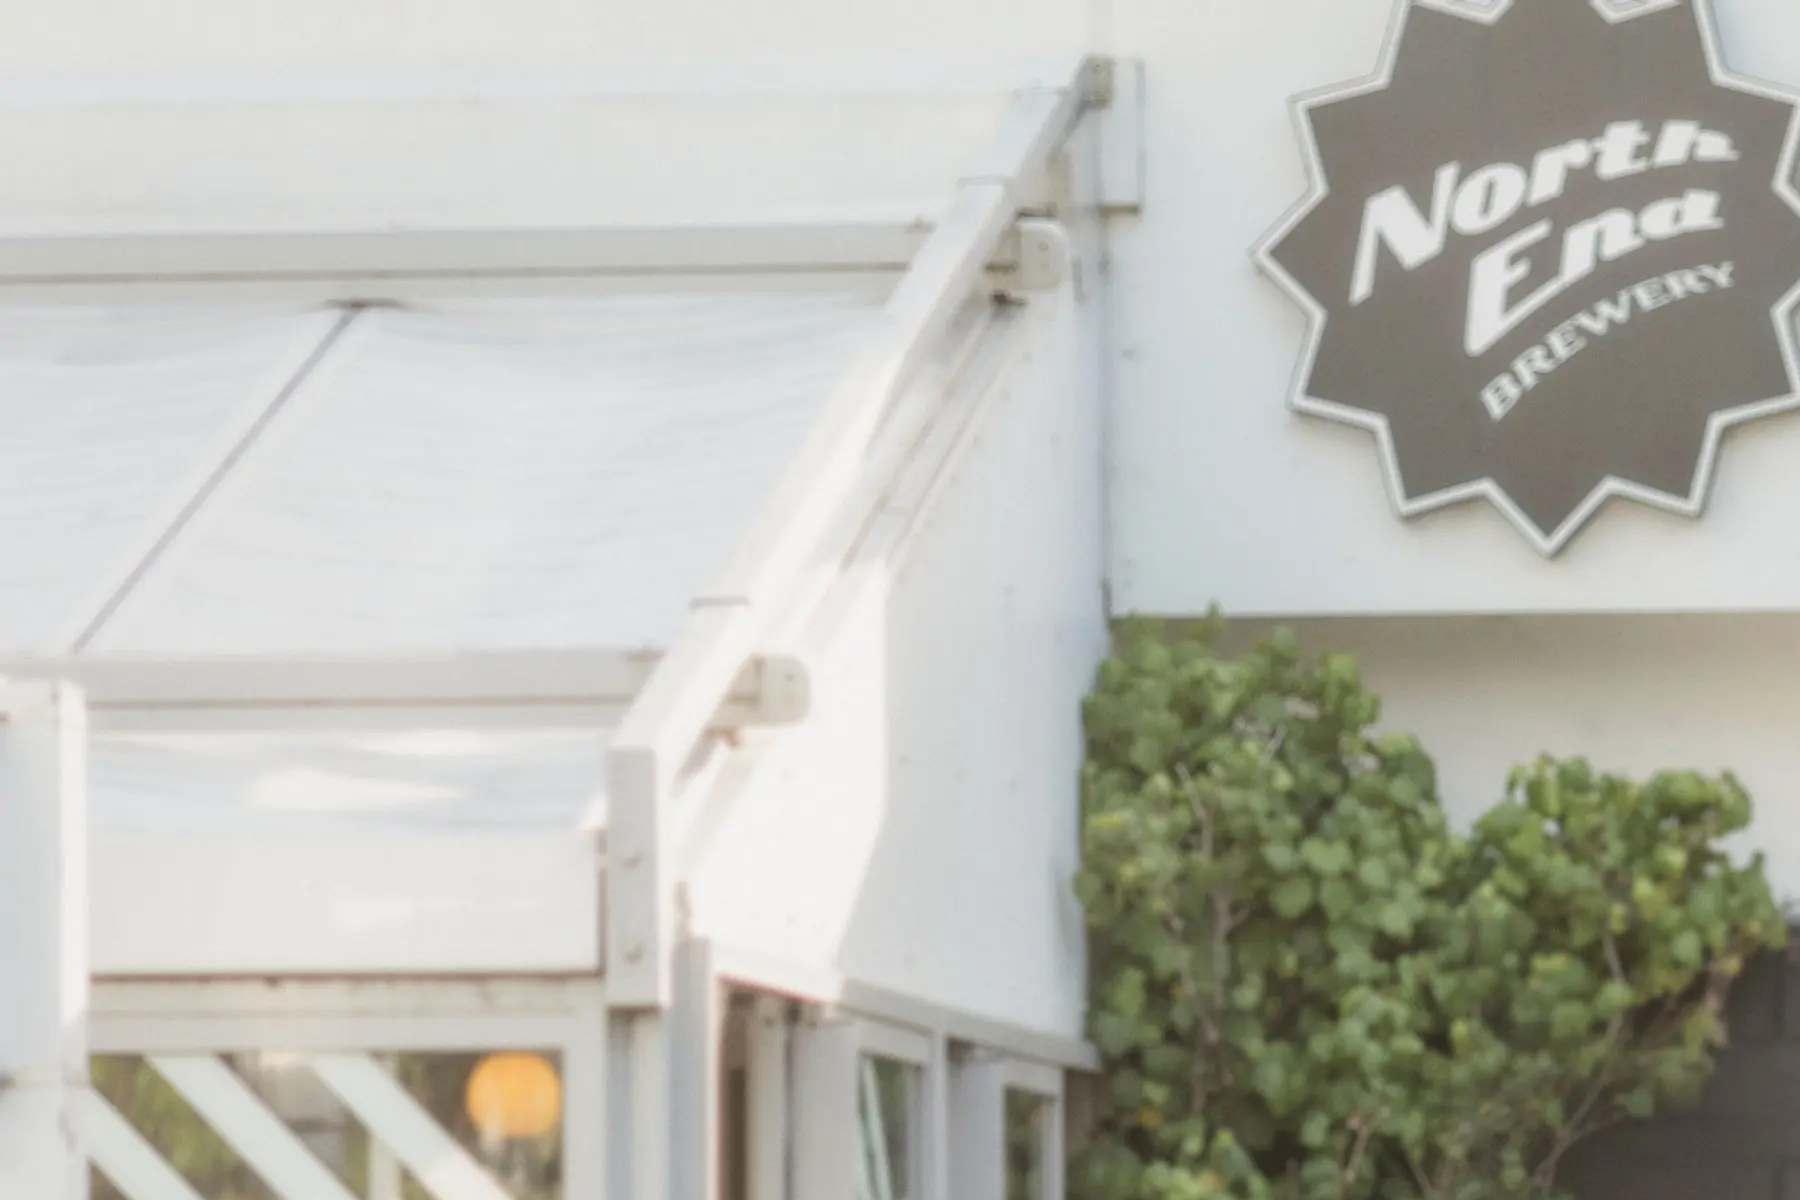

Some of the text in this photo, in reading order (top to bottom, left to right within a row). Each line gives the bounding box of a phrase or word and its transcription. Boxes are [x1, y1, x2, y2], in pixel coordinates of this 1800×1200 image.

[1348, 120, 1740, 305] North
[1464, 189, 1725, 357] End
[1480, 261, 1736, 421] BREWERY
